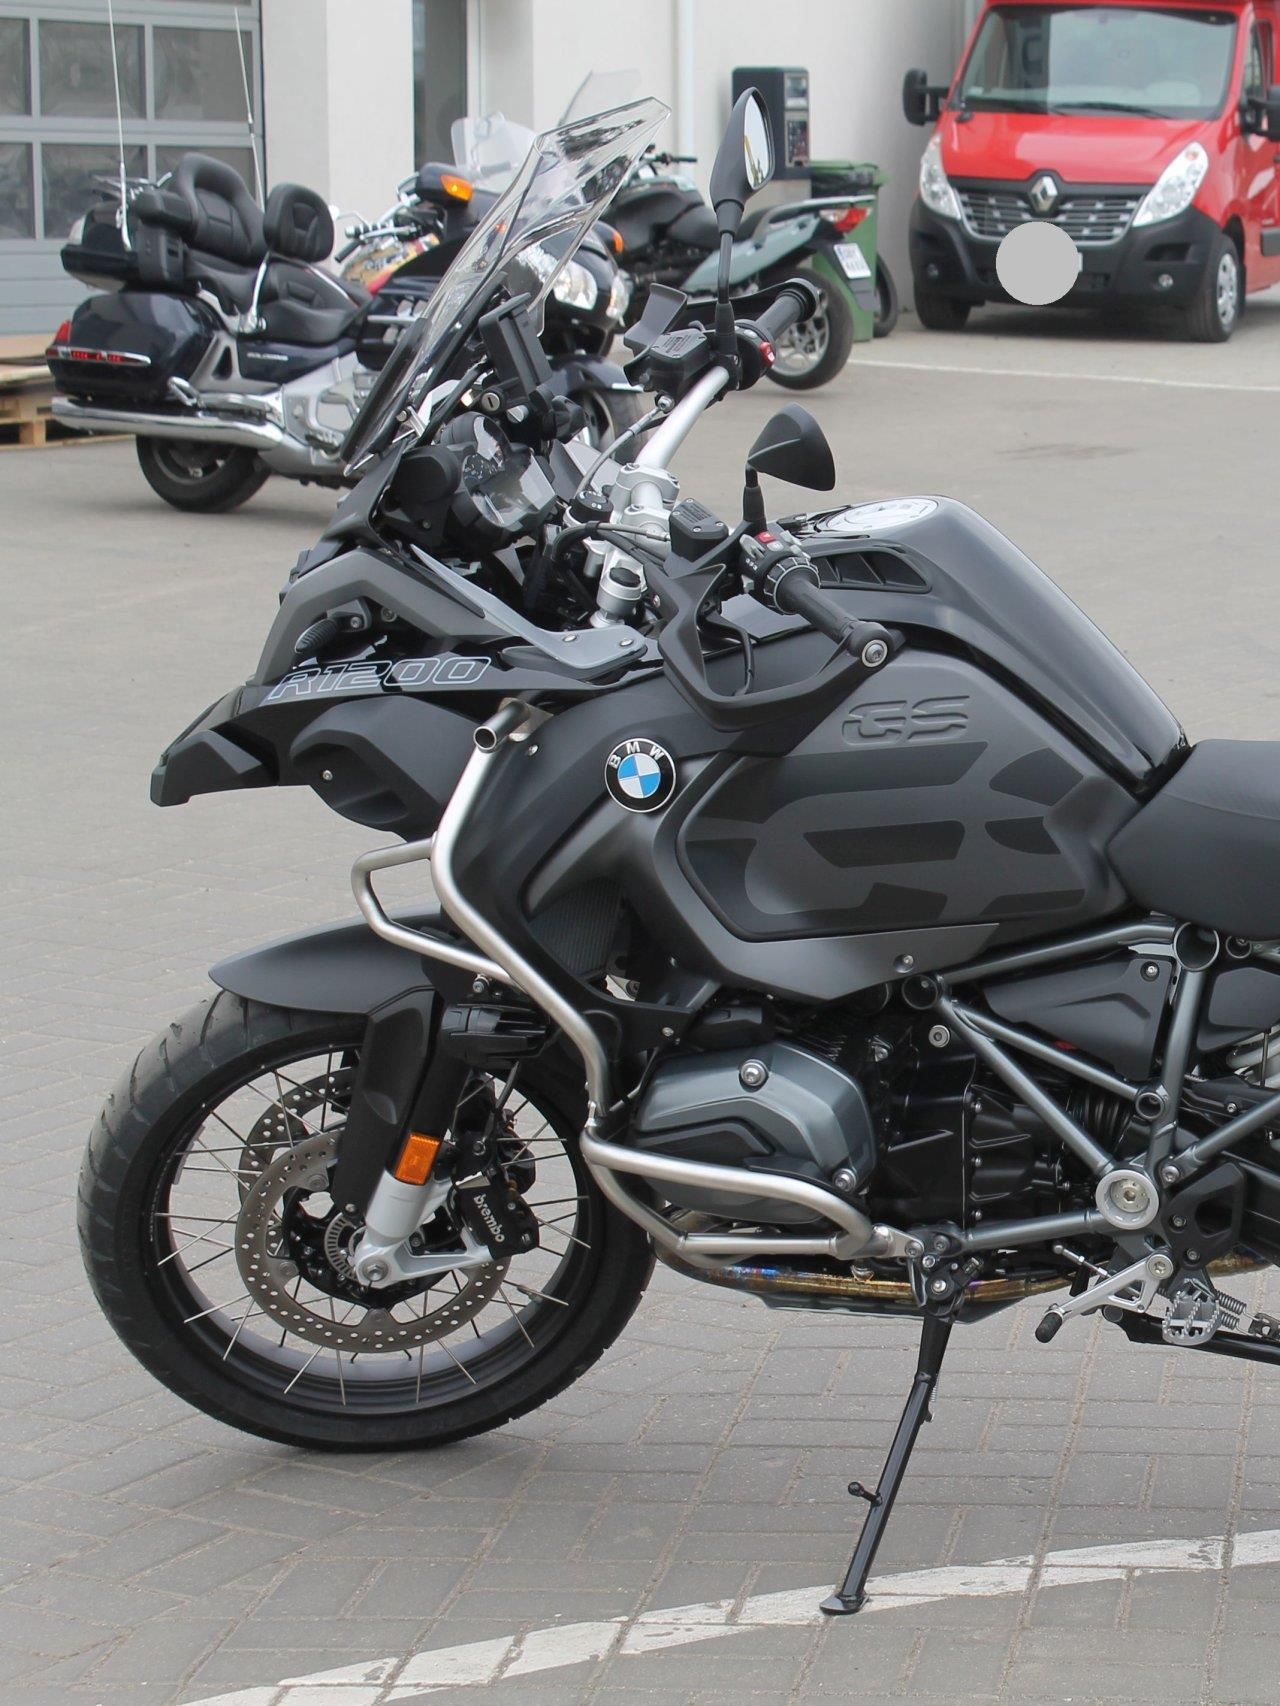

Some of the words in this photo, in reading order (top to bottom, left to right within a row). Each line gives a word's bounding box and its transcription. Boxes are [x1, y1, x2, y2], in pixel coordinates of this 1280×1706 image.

[267, 656, 492, 700] R1200
[841, 695, 970, 746] GS
[608, 740, 665, 769] BMW
[473, 1193, 506, 1243] brembo
